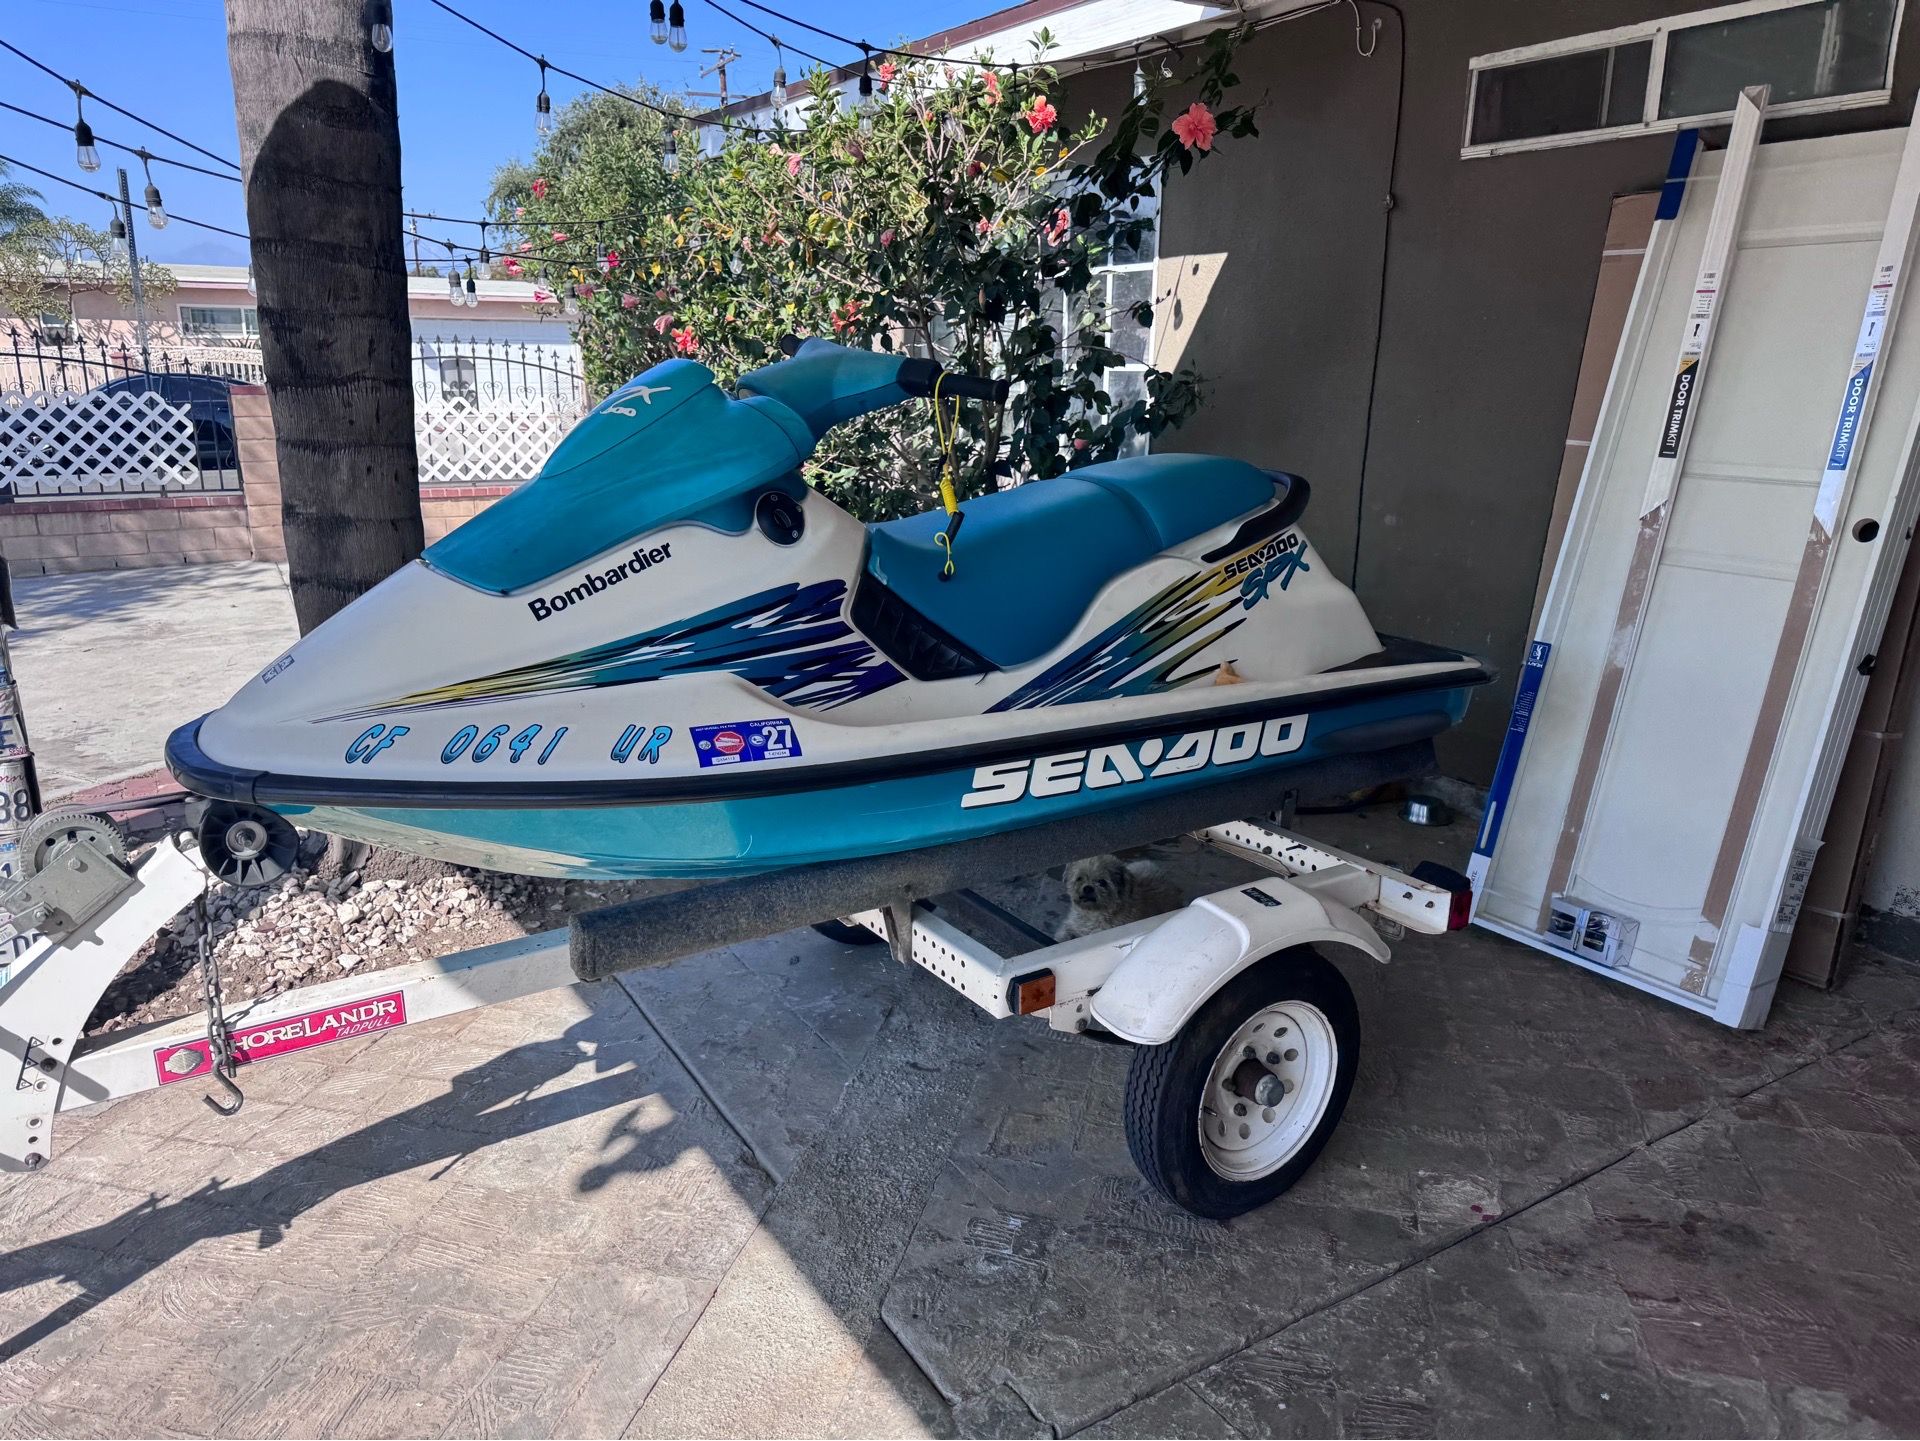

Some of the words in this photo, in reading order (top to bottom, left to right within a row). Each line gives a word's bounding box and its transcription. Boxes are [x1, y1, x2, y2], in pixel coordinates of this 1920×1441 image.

[1676, 374, 1691, 407] DOOR
[1847, 377, 1863, 412] DOOR
[528, 542, 672, 621] Bombardier
[1240, 540, 1310, 611] SPX
[345, 723, 410, 764] CF
[441, 724, 569, 764] 0641
[610, 724, 673, 764] UR
[762, 725, 793, 750] 27
[336, 1016, 391, 1038] TADPULL
